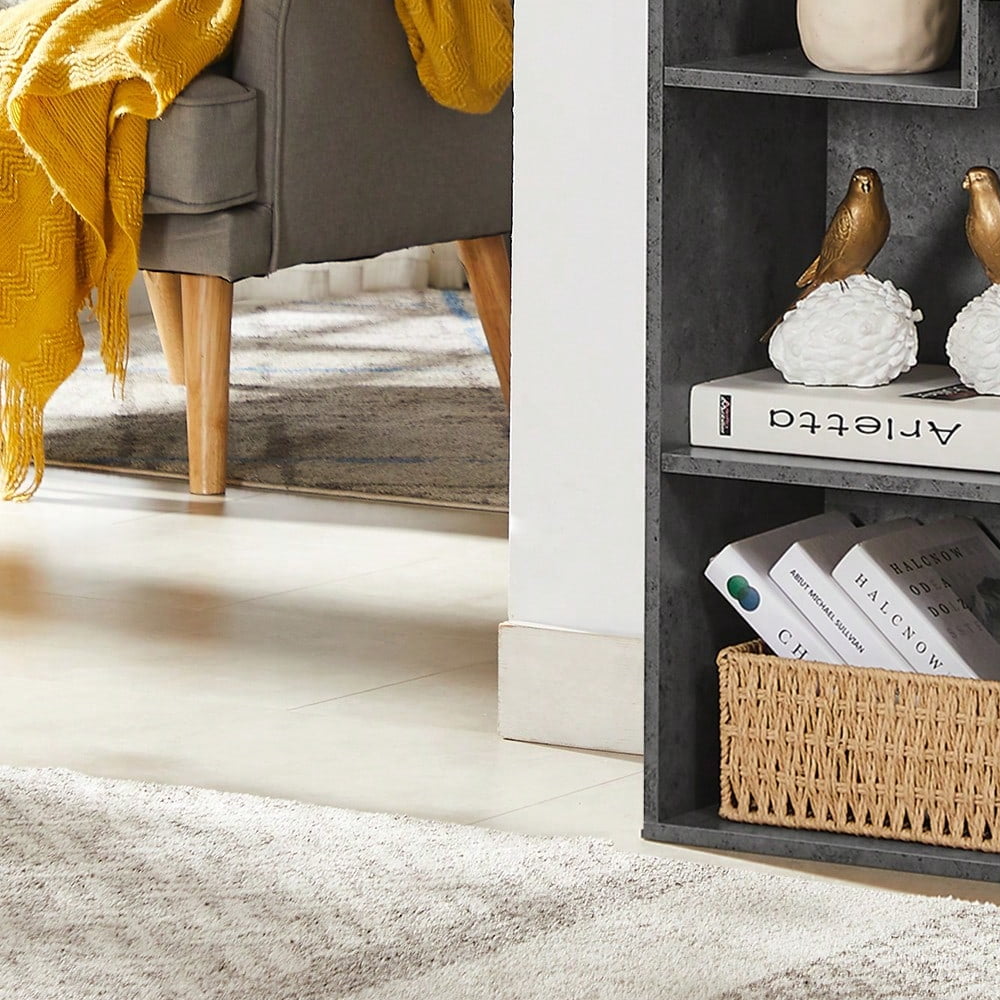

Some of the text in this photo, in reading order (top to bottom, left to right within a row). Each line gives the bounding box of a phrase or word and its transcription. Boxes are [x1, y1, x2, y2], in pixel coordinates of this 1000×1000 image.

[768, 407, 963, 446] Arletta
[807, 589, 836, 622] MICHAEL
[854, 572, 944, 671] HALCNOW
